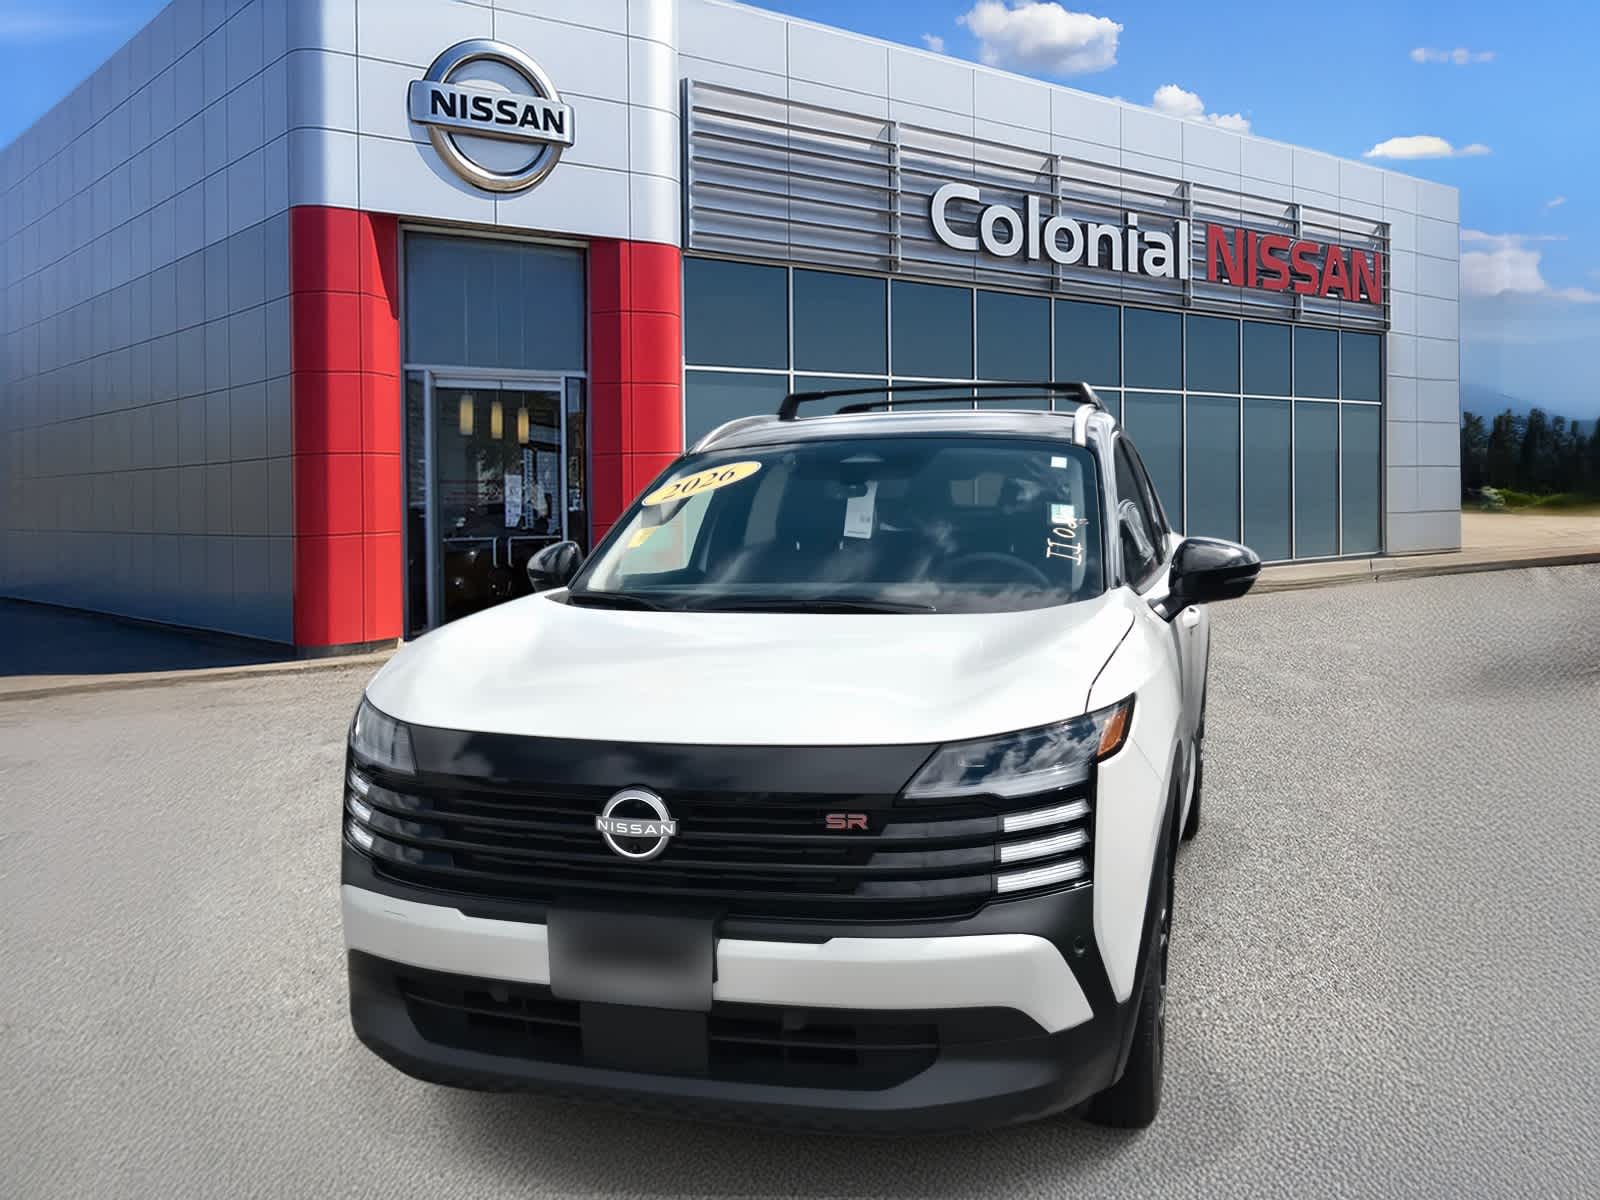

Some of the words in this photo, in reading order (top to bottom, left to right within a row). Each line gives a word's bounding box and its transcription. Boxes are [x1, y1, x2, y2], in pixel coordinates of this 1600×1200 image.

[430, 89, 564, 134] NISSAN
[931, 183, 1189, 280] Colonial
[1207, 223, 1382, 305] NISSAN
[662, 468, 736, 500] 2026
[598, 818, 674, 835] NISSAN
[825, 813, 869, 830] SR
